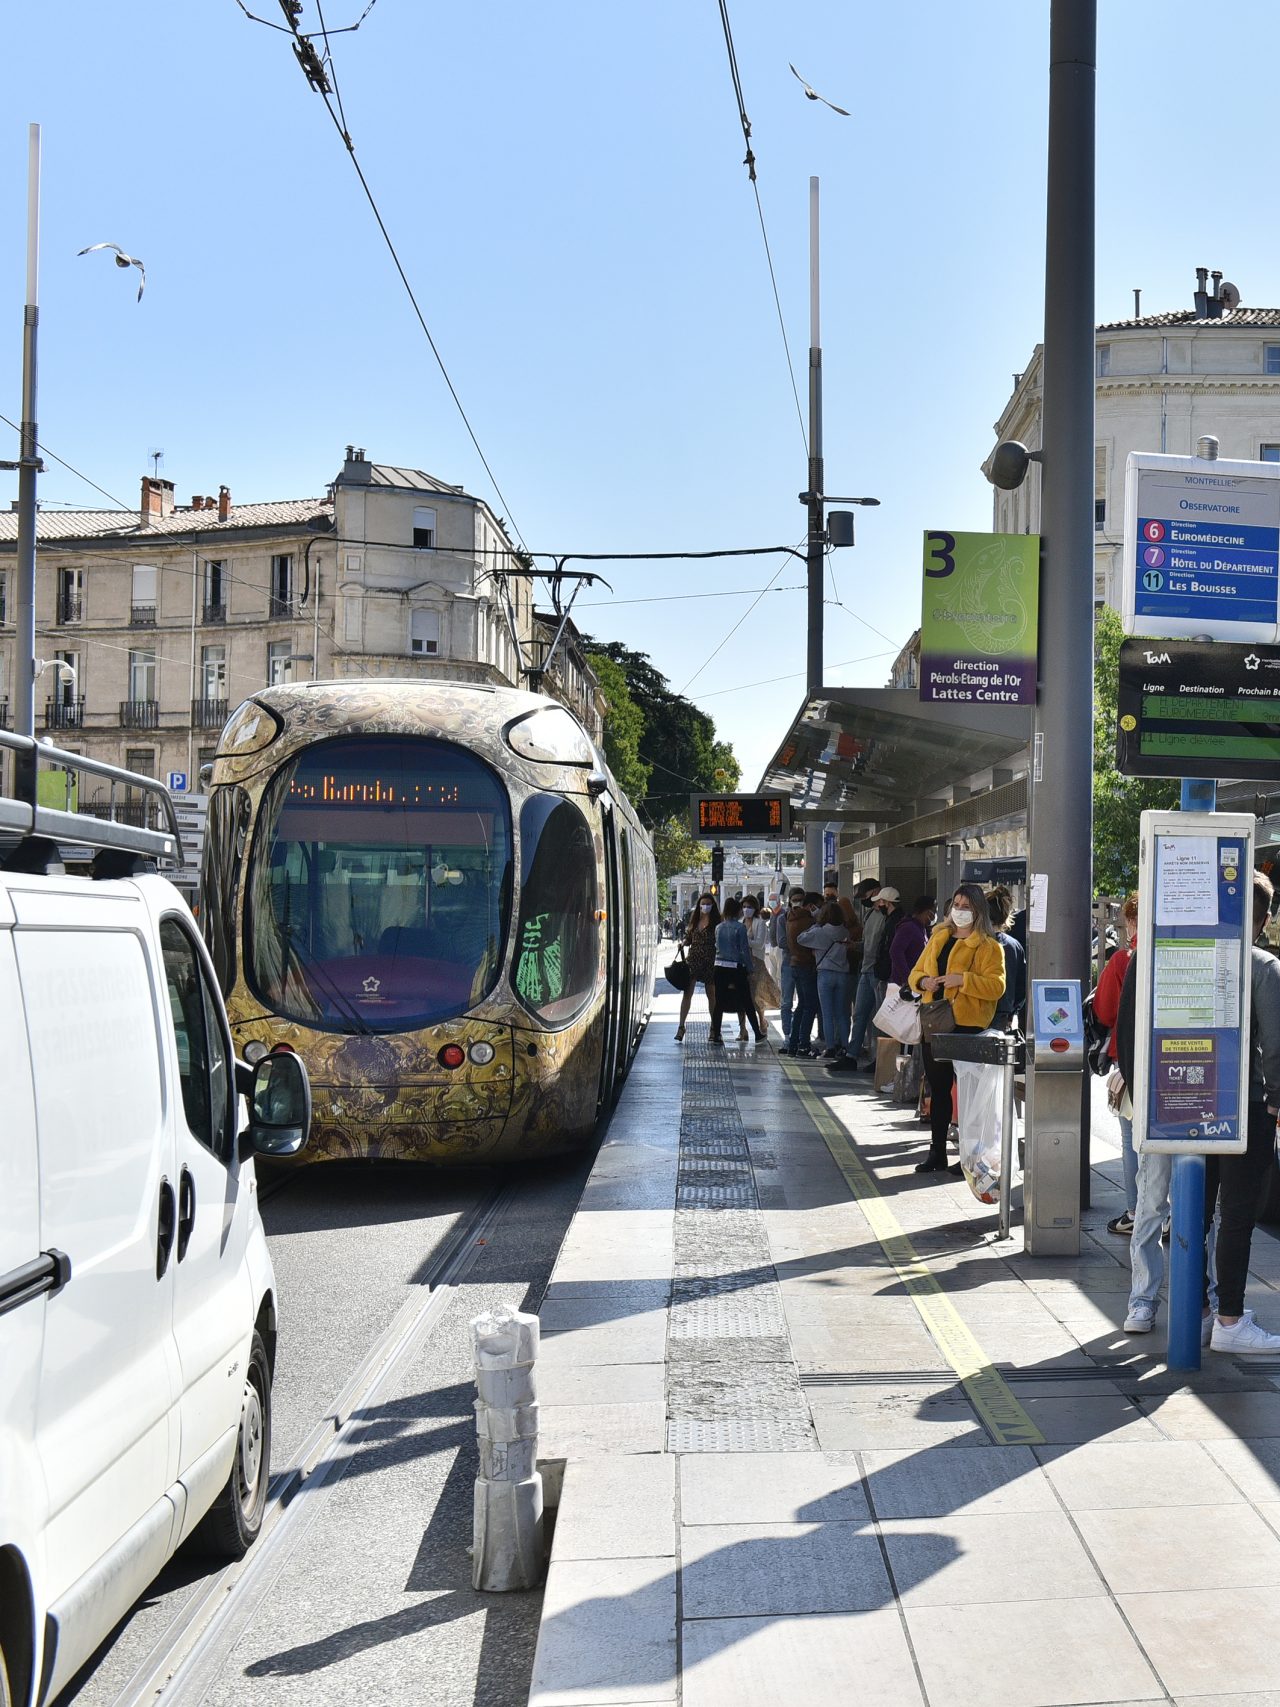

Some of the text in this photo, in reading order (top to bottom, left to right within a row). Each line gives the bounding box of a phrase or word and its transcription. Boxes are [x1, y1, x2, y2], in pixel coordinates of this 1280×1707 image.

[1179, 499, 1240, 514] OBSERVATOIRE
[1149, 524, 1244, 545] 6 EUROMÉDECINE
[926, 531, 956, 578] 3
[1149, 548, 1274, 574] 7 HÔTEL DU DÉPARTEMENT
[1144, 574, 1237, 594] 11 LES BOUISSES
[954, 660, 1000, 671] direction
[990, 674, 1002, 686] de
[1004, 674, 1022, 686] l'Or
[932, 688, 1018, 702] Lattes Centre
[1143, 684, 1164, 692] Ligne
[1180, 684, 1224, 694] Destination
[1238, 686, 1271, 697] Prochain
